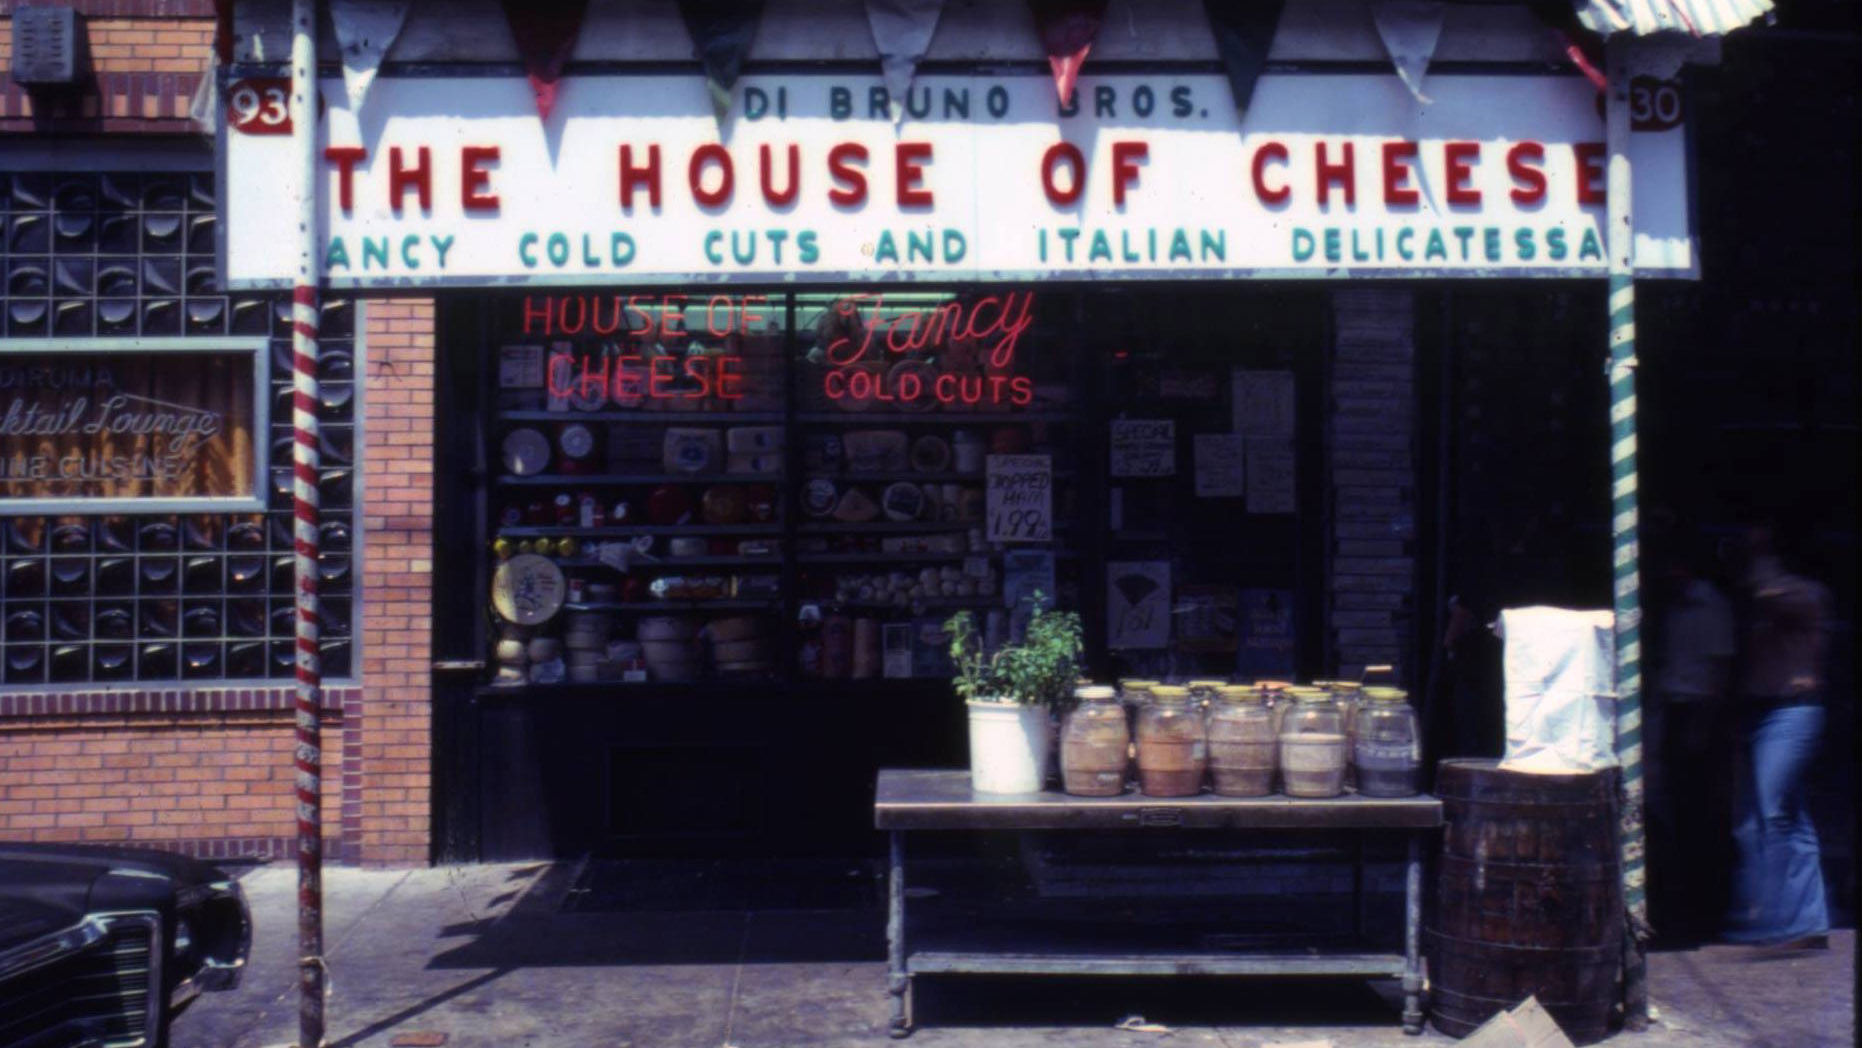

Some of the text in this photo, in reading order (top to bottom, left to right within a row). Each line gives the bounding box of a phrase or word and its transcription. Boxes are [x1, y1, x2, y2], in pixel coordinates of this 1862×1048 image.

[232, 86, 292, 125] 93
[744, 85, 1209, 120] DI BRUNO BROS.
[1631, 86, 1681, 123] 30
[325, 141, 1607, 213] THE HOUSE OF CHEESE
[325, 226, 1603, 270] ANCY COLD CUTS AND ITALIAN DELICATESSA
[521, 293, 768, 338] HOUSE OF
[826, 291, 1034, 368] Fancy
[546, 352, 745, 400] CHEESE
[824, 370, 1034, 406] COLD CUTS
[0, 394, 218, 452] ktail Lounge
